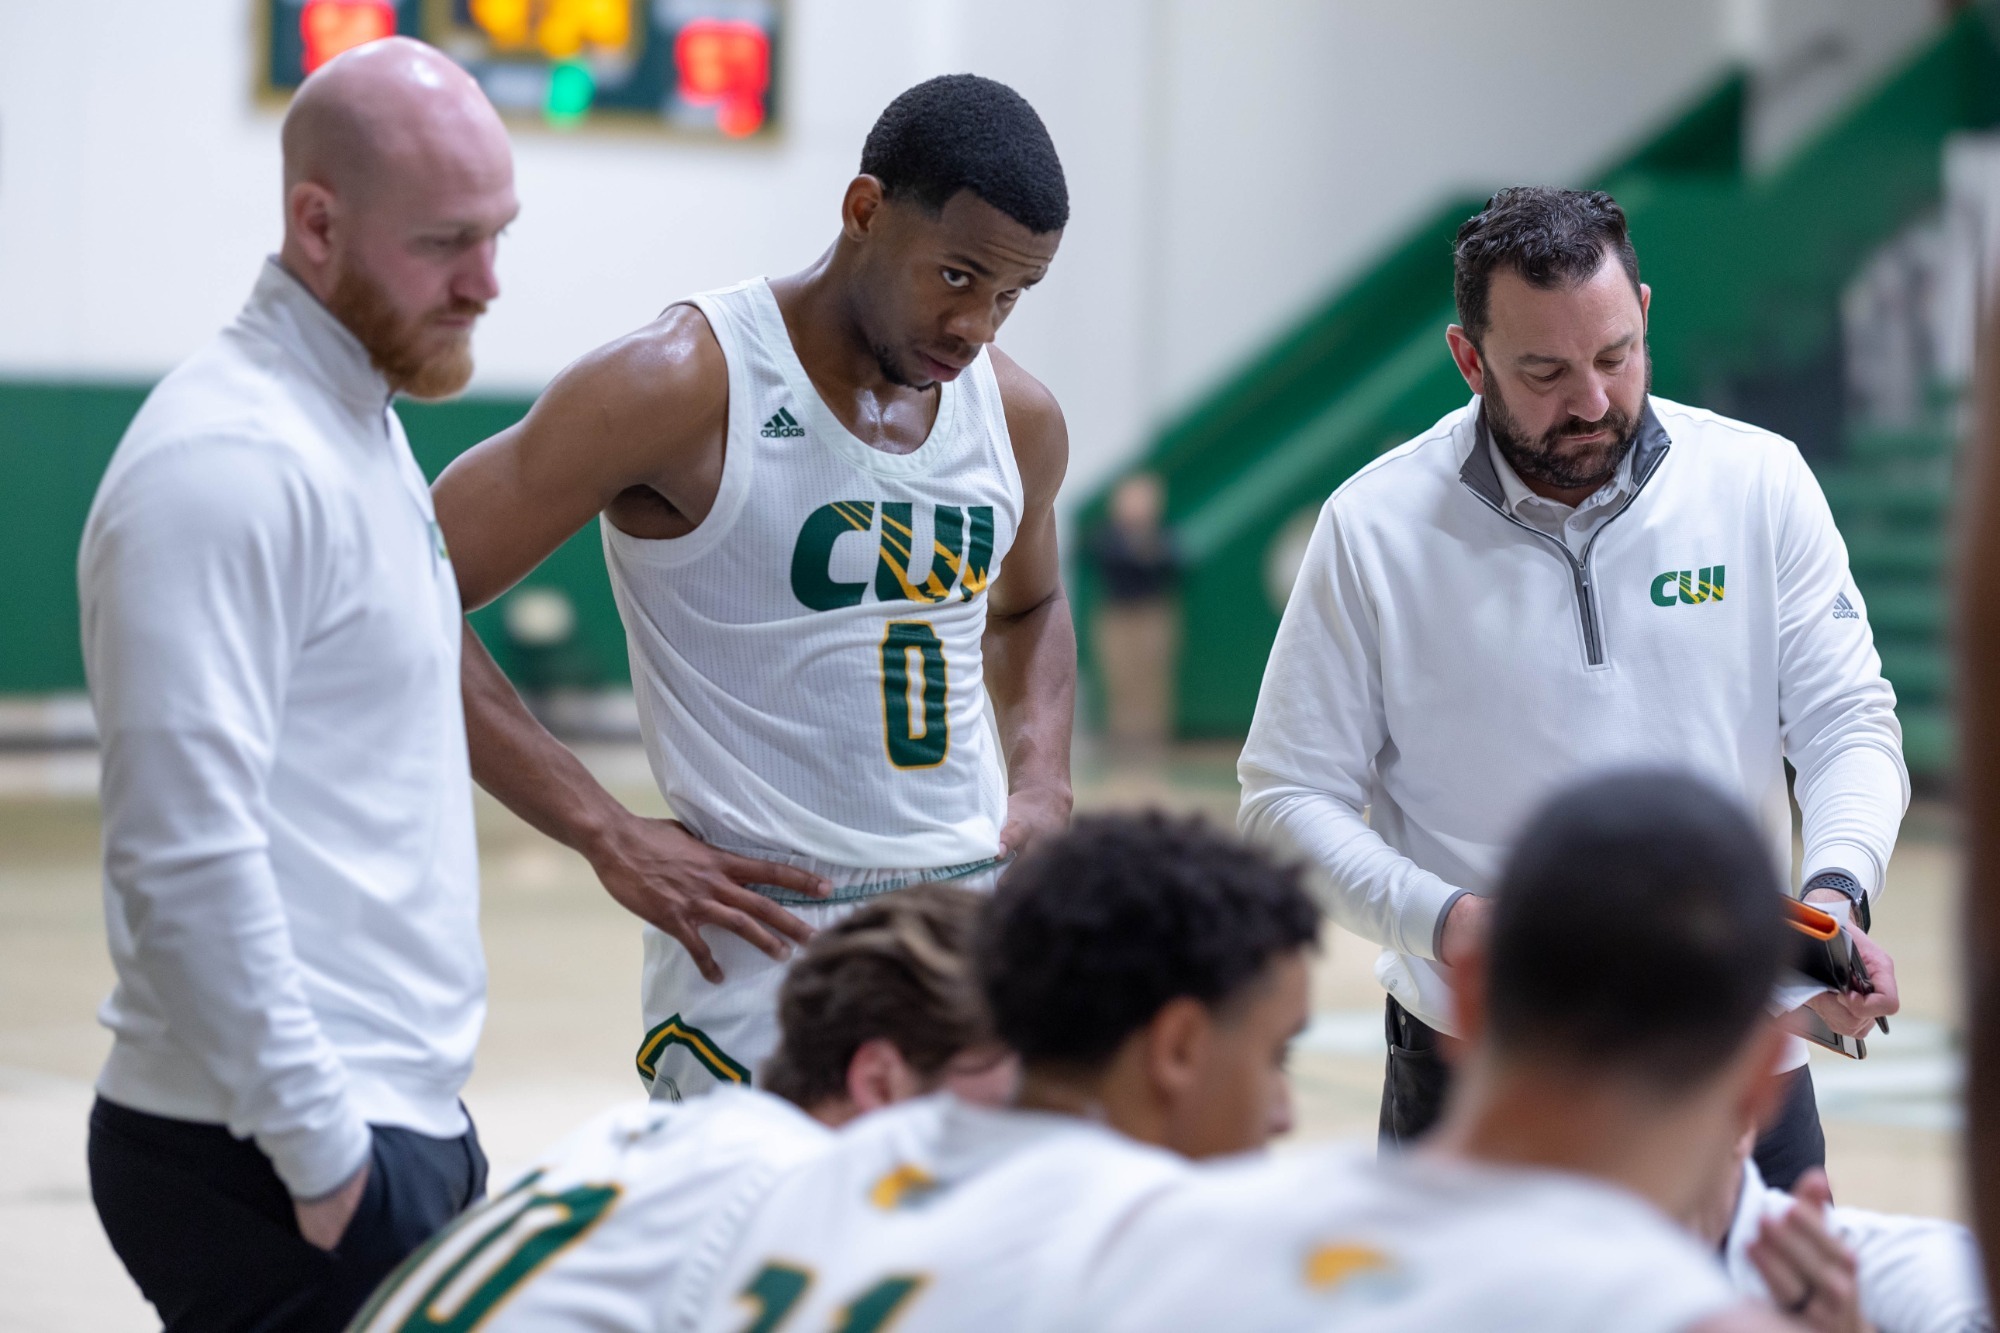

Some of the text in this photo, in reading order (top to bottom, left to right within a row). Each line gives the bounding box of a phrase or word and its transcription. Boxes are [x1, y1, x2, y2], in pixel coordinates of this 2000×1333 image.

[761, 426, 805, 438] adidas
[791, 501, 994, 611] CUI
[1650, 565, 1726, 607] CUI
[879, 620, 949, 770] 0
